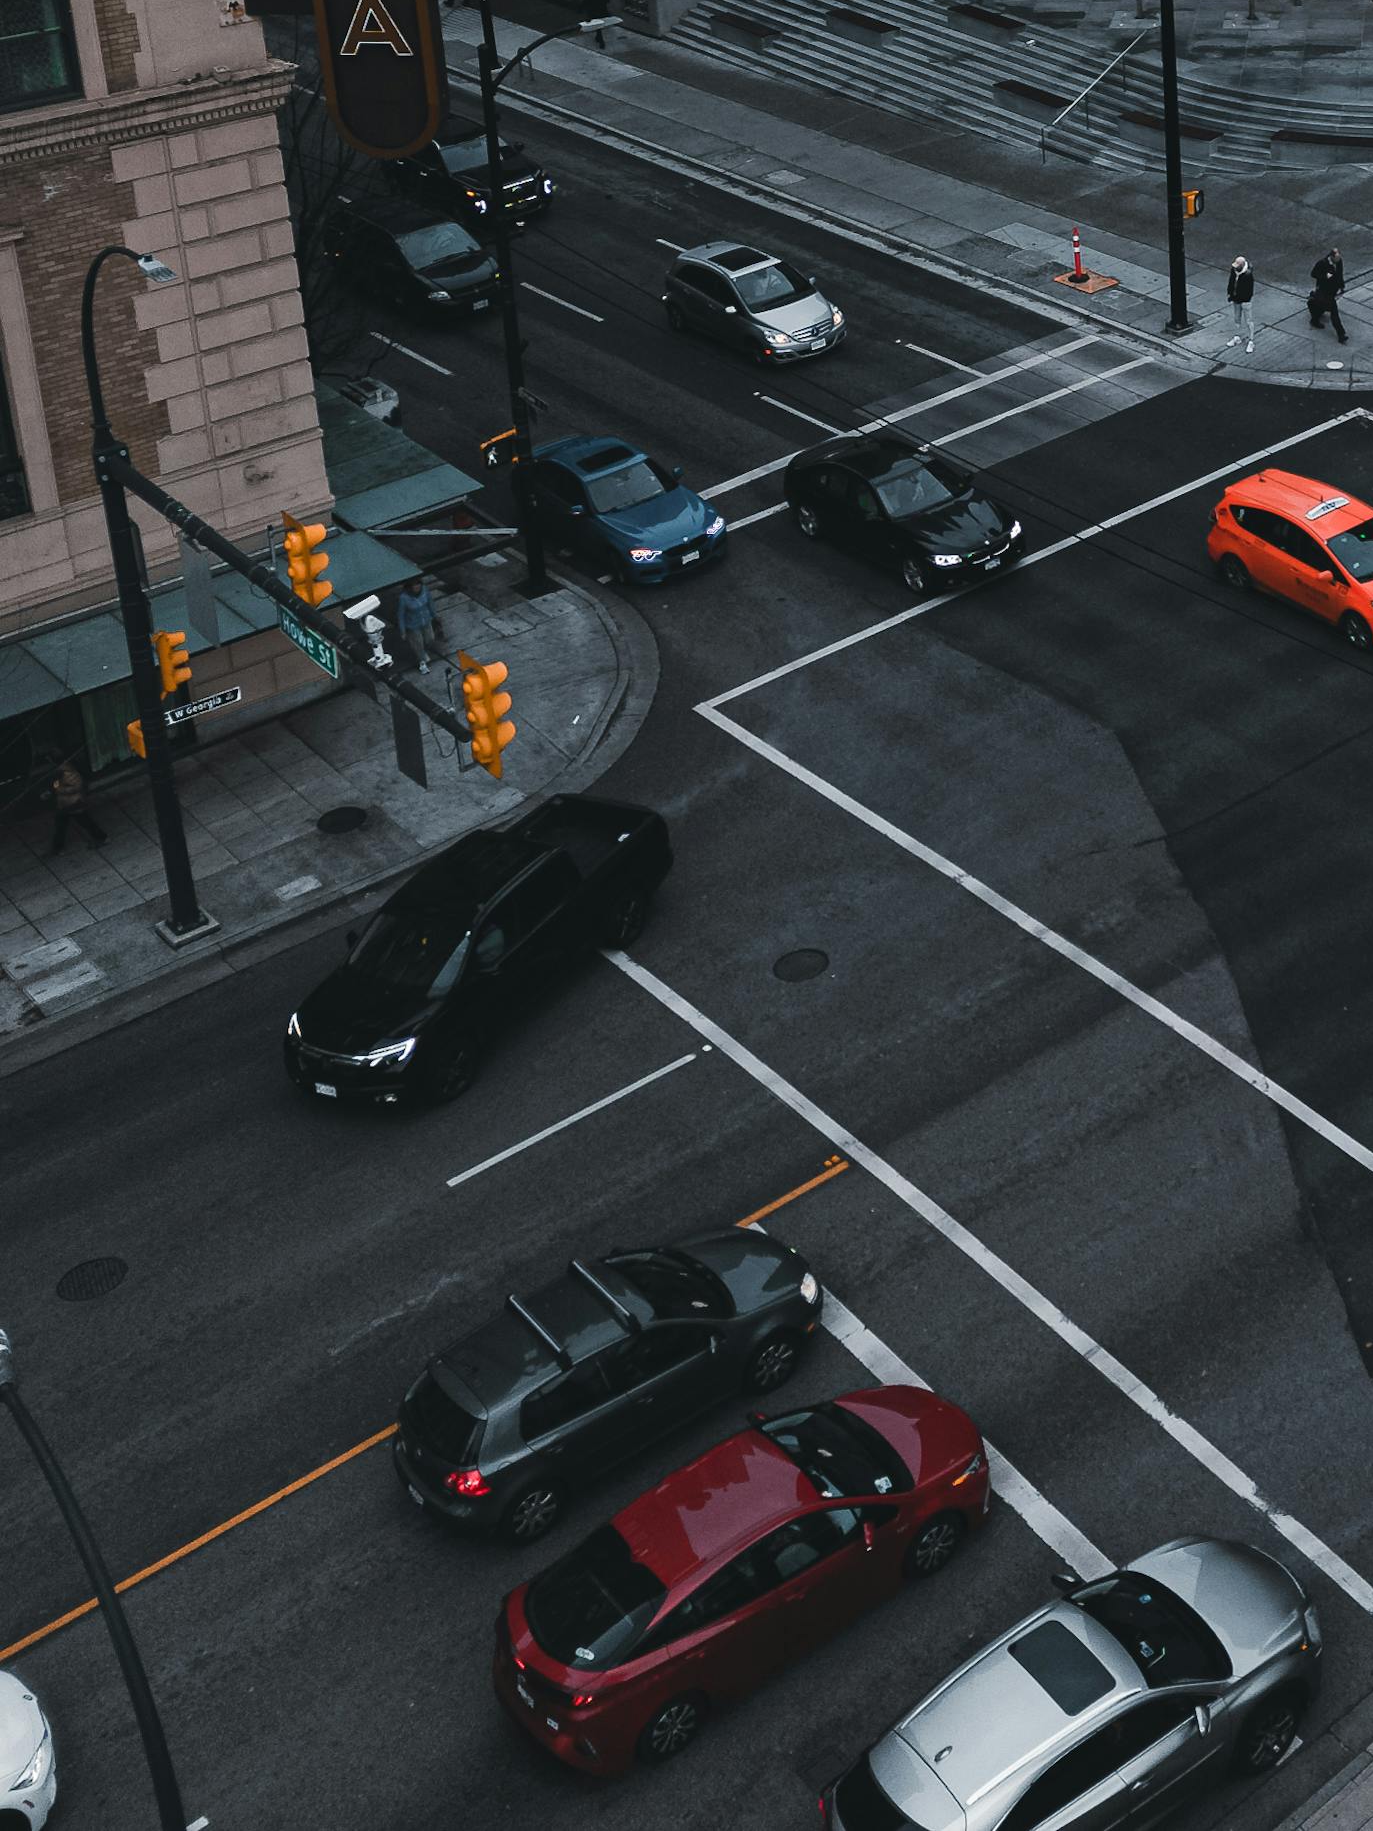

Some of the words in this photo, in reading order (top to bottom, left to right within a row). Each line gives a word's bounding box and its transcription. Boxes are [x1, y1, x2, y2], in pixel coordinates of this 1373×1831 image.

[282, 612, 314, 655] Howe
[318, 643, 332, 669] St
[174, 710, 184, 719] W
[186, 696, 222, 714] Georgia
